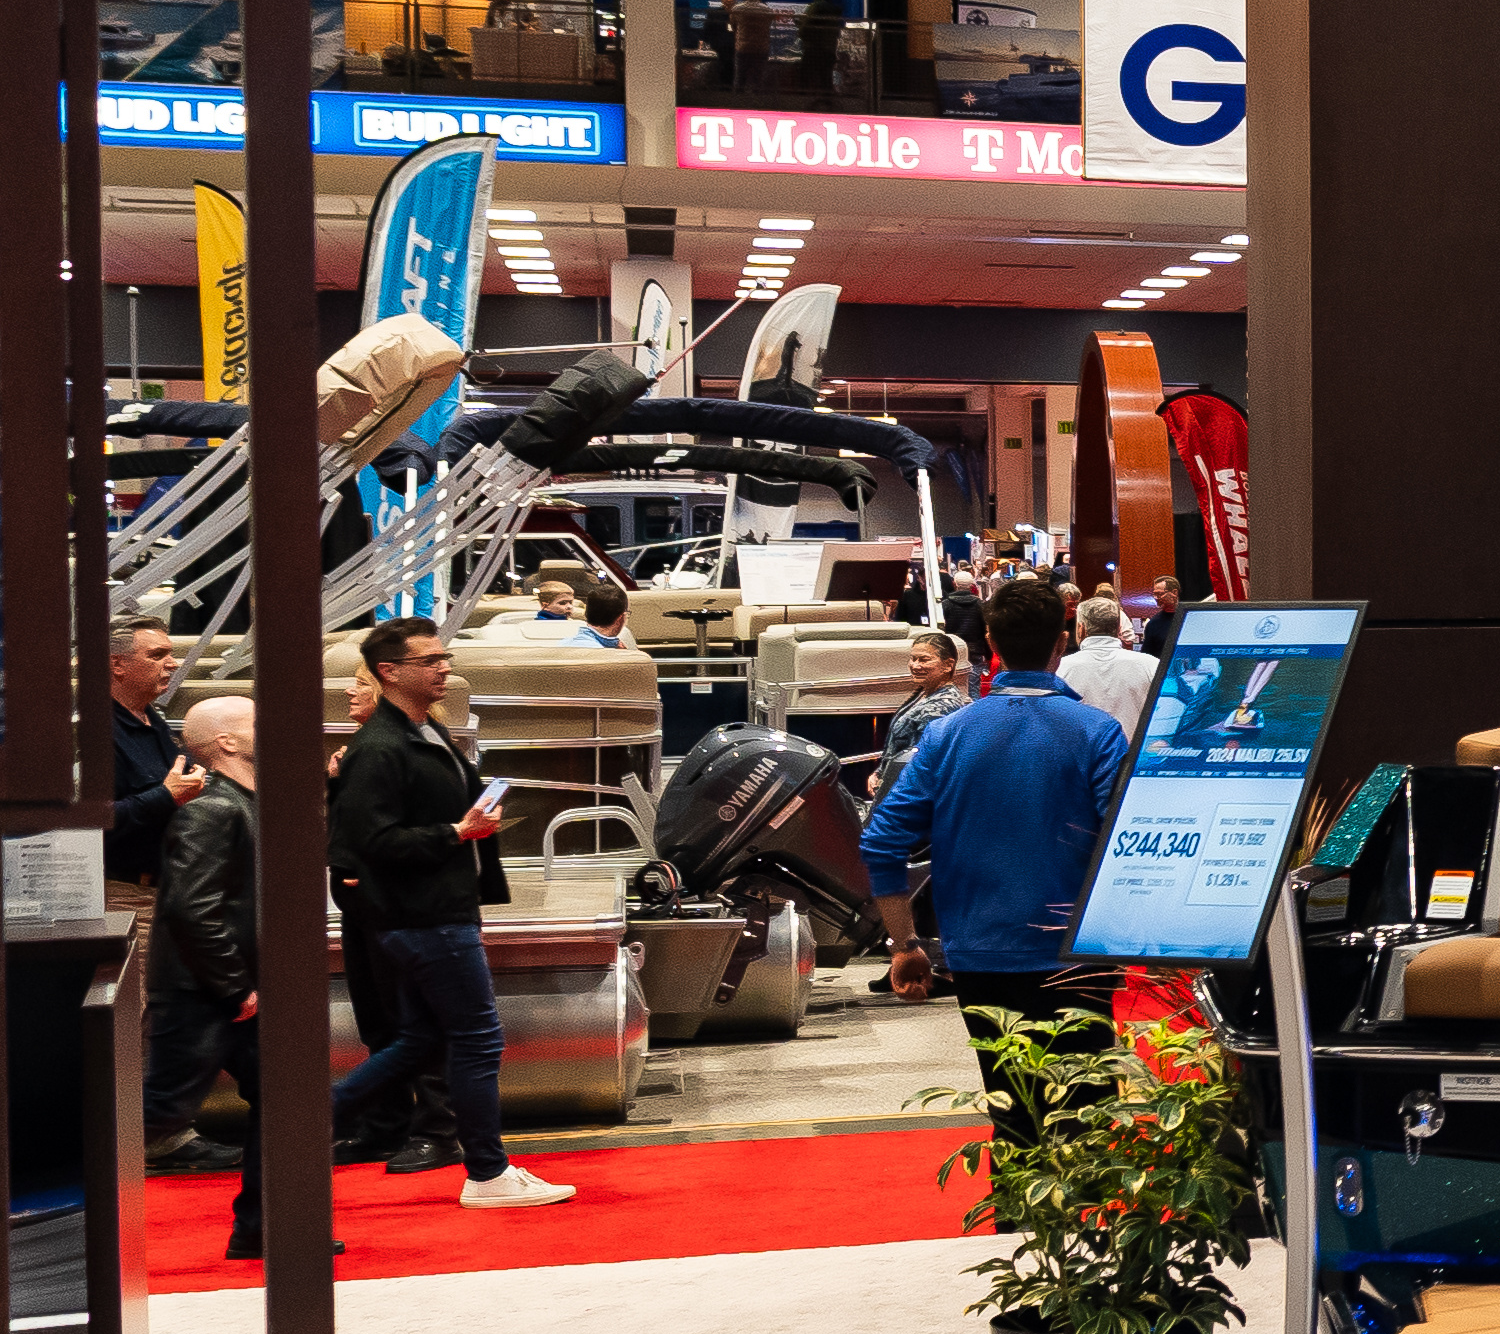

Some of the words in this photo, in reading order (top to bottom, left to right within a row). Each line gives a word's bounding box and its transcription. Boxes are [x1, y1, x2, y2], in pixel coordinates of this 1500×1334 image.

[1118, 23, 1247, 147] G
[101, 98, 171, 132] UD
[172, 99, 246, 135] LIG
[361, 108, 459, 143] BUD
[747, 117, 920, 171] Mobile
[727, 756, 779, 808] YAMAHA
[1113, 830, 1201, 860] $244,340
